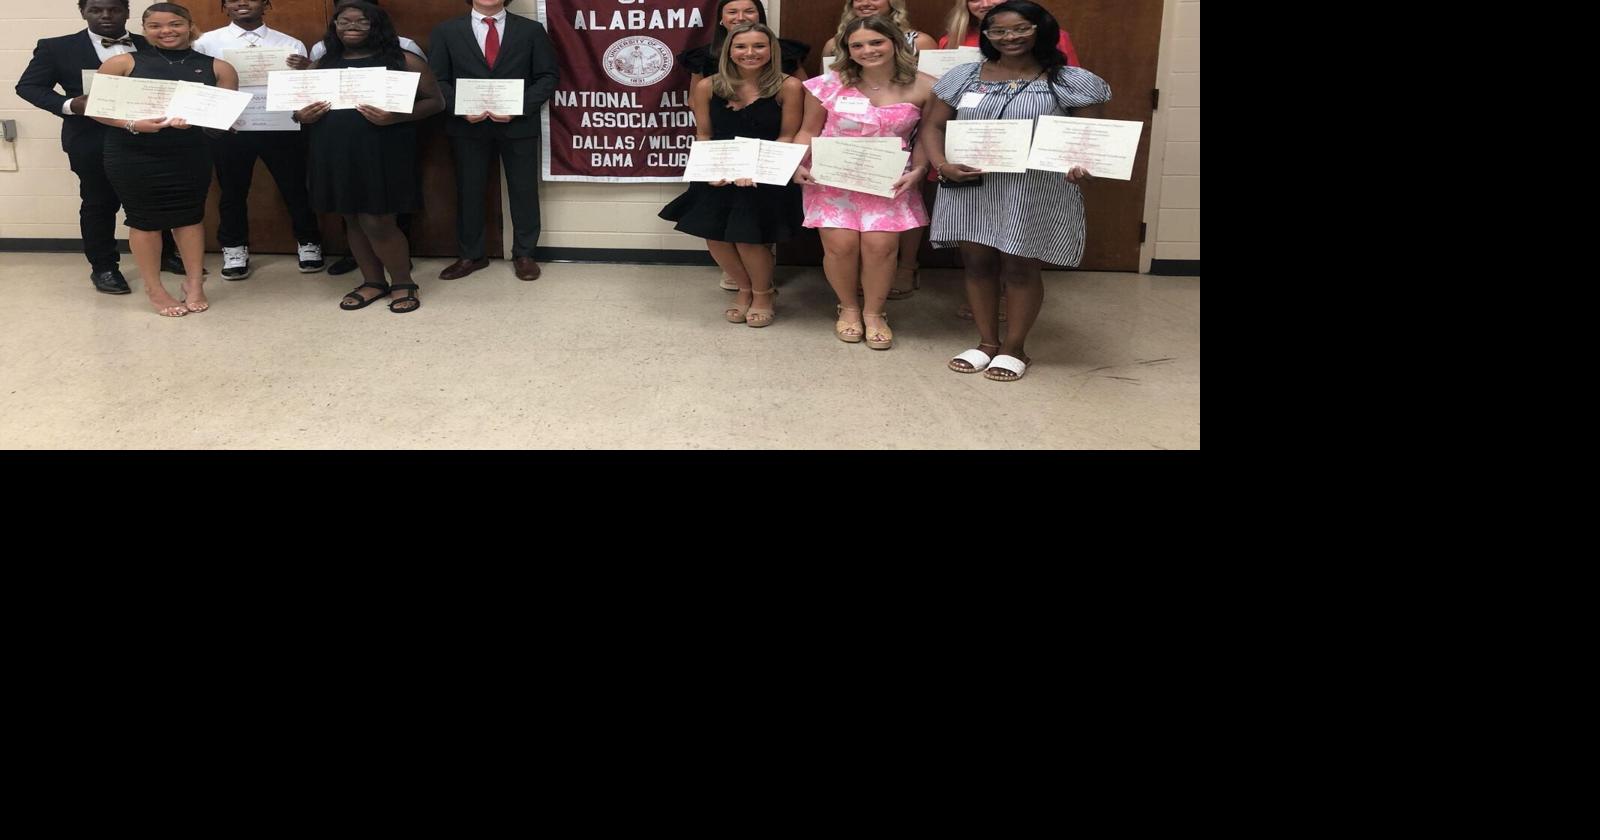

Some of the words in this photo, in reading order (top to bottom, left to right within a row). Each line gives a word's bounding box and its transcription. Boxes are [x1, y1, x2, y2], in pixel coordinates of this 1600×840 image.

[574, 7, 704, 30] ALABAMA
[610, 40, 644, 58] UNIVERSITY
[554, 90, 643, 108] NATIONAL
[581, 111, 697, 128] ASSOCIATION
[591, 153, 634, 167] BAMA
[647, 152, 689, 167] CLUB
